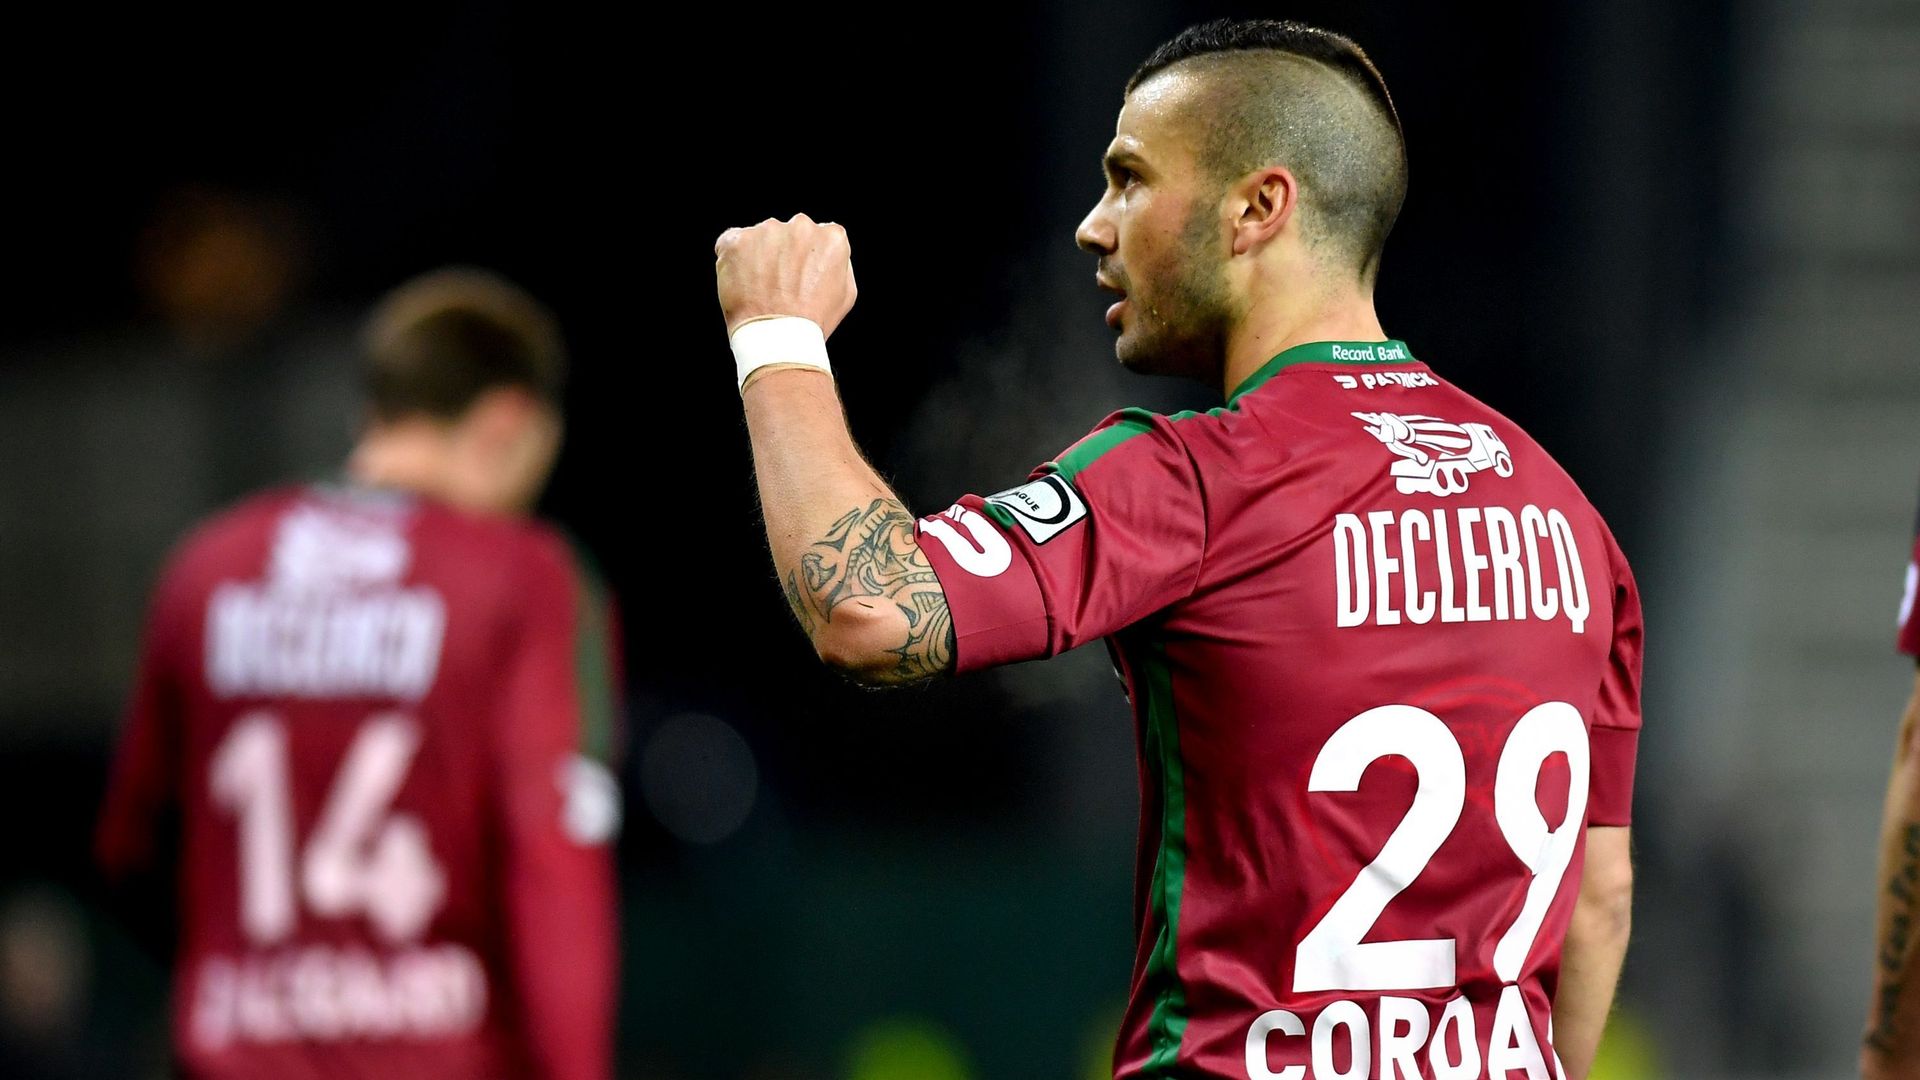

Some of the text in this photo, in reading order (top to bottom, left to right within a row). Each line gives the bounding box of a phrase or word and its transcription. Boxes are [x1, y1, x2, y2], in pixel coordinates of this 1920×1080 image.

[1332, 344, 1407, 361] Record Bank
[1360, 371, 1440, 390] PATRICK
[1333, 504, 1590, 634] DECLERCQ
[209, 711, 448, 945] 14
[1292, 701, 1590, 993] 29
[1245, 984, 1568, 1080] CORDA
